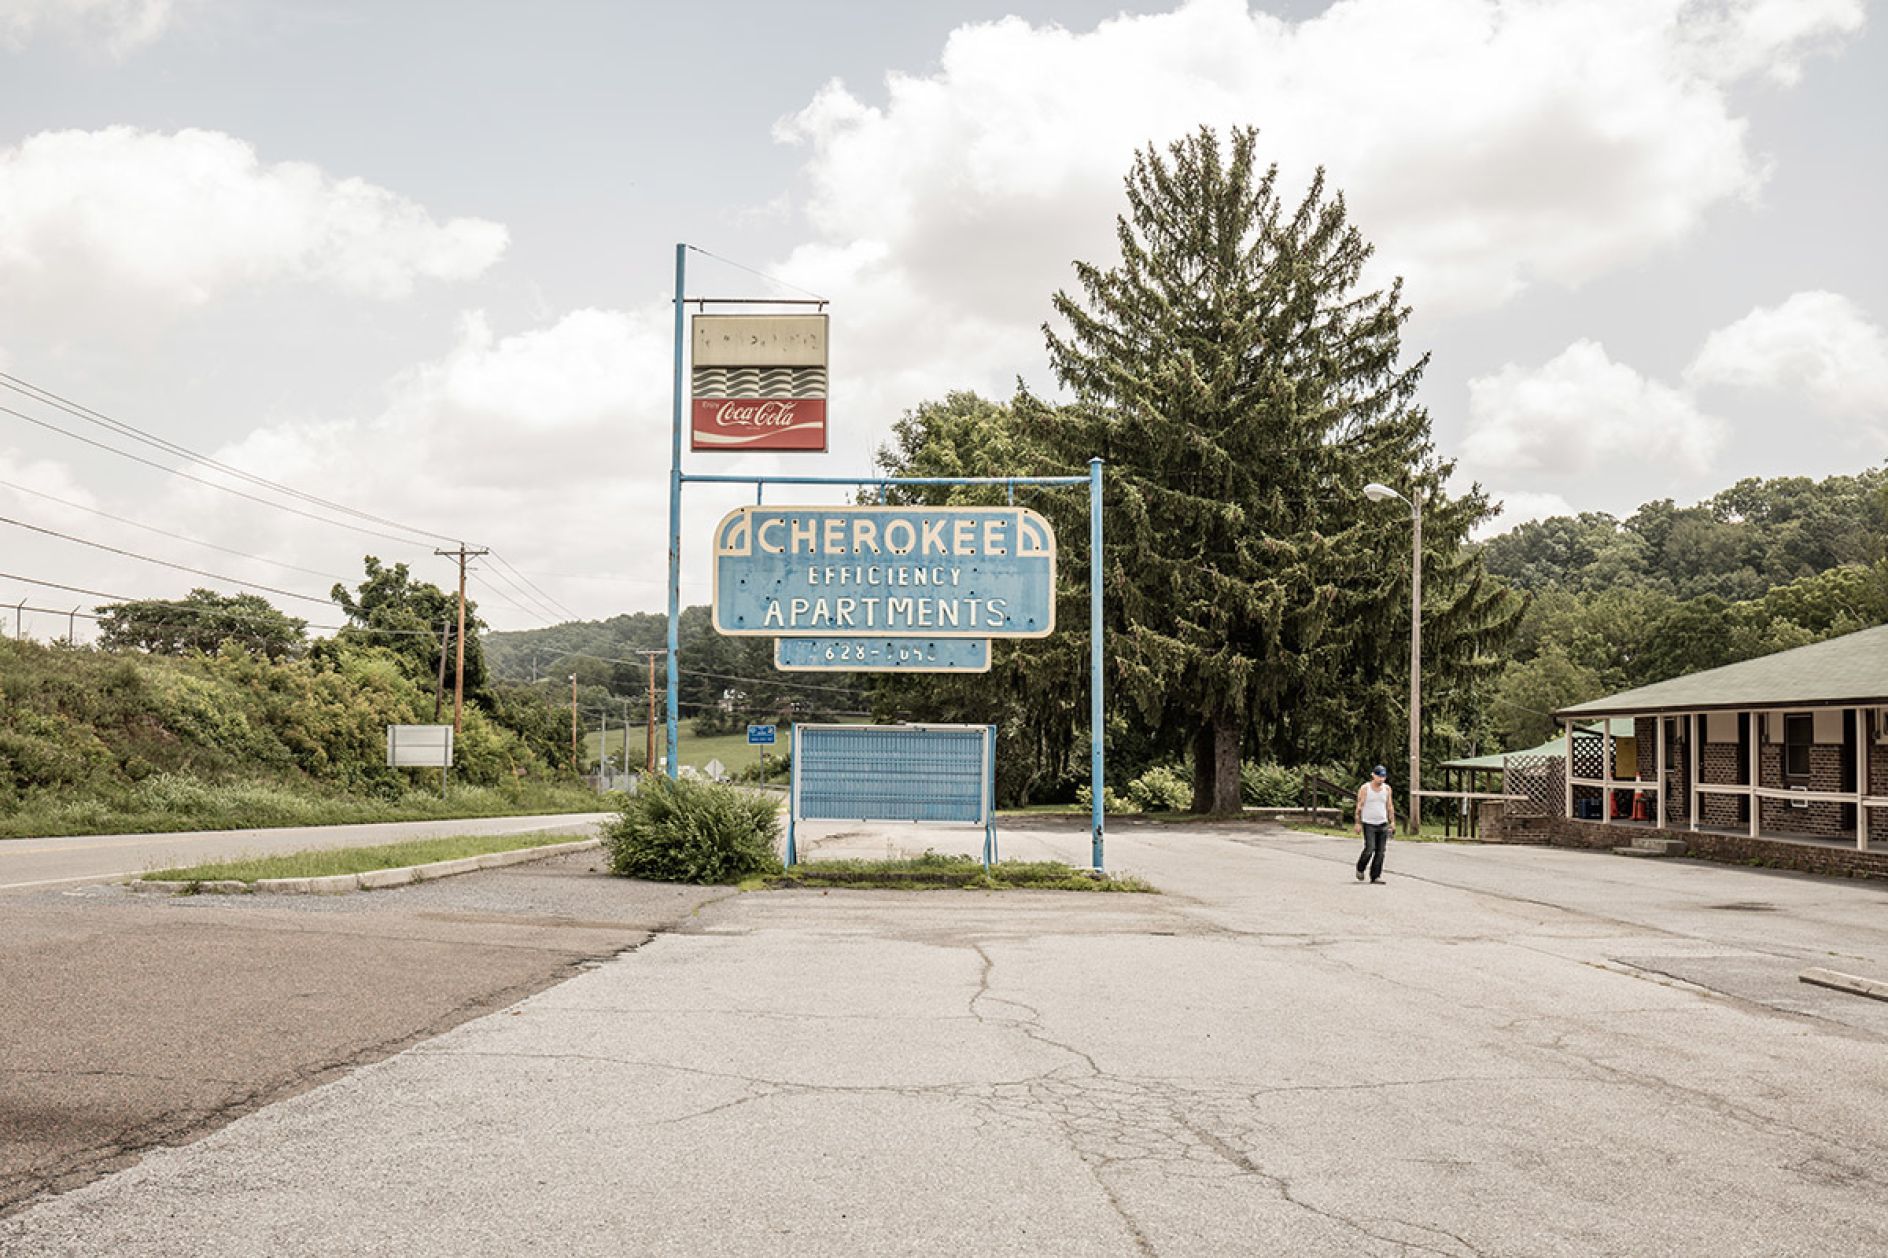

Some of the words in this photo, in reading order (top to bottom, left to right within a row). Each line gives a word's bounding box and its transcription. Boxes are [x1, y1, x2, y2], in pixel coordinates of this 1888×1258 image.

[716, 401, 797, 426] Coca-Cola
[757, 518, 1008, 556] CHEROKEE
[808, 565, 961, 586] EFFICIENCY
[763, 597, 1008, 627] APARTMENTS
